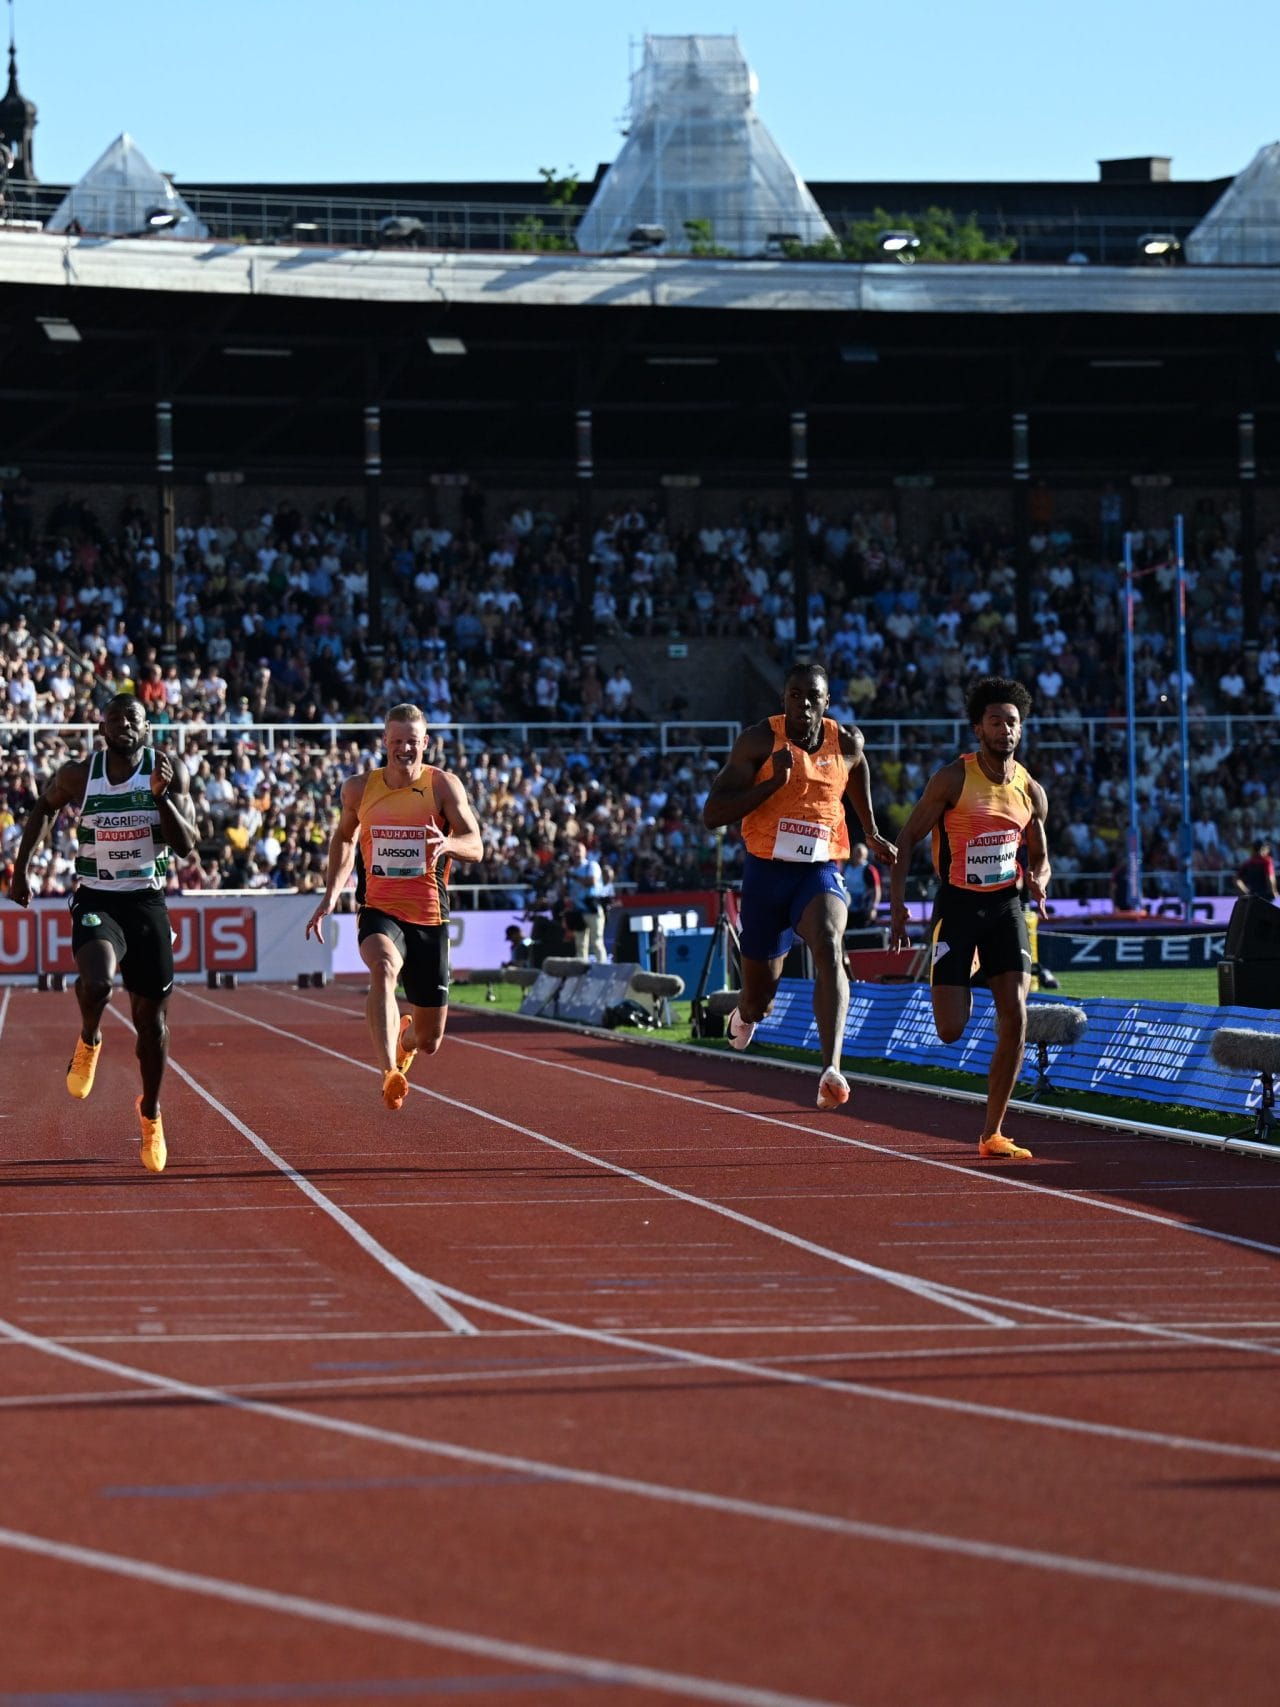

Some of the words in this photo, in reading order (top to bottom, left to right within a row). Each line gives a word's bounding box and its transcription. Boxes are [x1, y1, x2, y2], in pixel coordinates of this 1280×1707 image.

[97, 828, 151, 840] BAUHAUS
[372, 830, 424, 839] BAUHAUS
[781, 822, 829, 840] BAUHAUS
[969, 834, 1017, 847] BAUHAUS
[108, 849, 142, 860] ESEME
[377, 848, 419, 858] LARSSON
[796, 845, 813, 856] ALI
[967, 851, 1015, 864] HARTMANN
